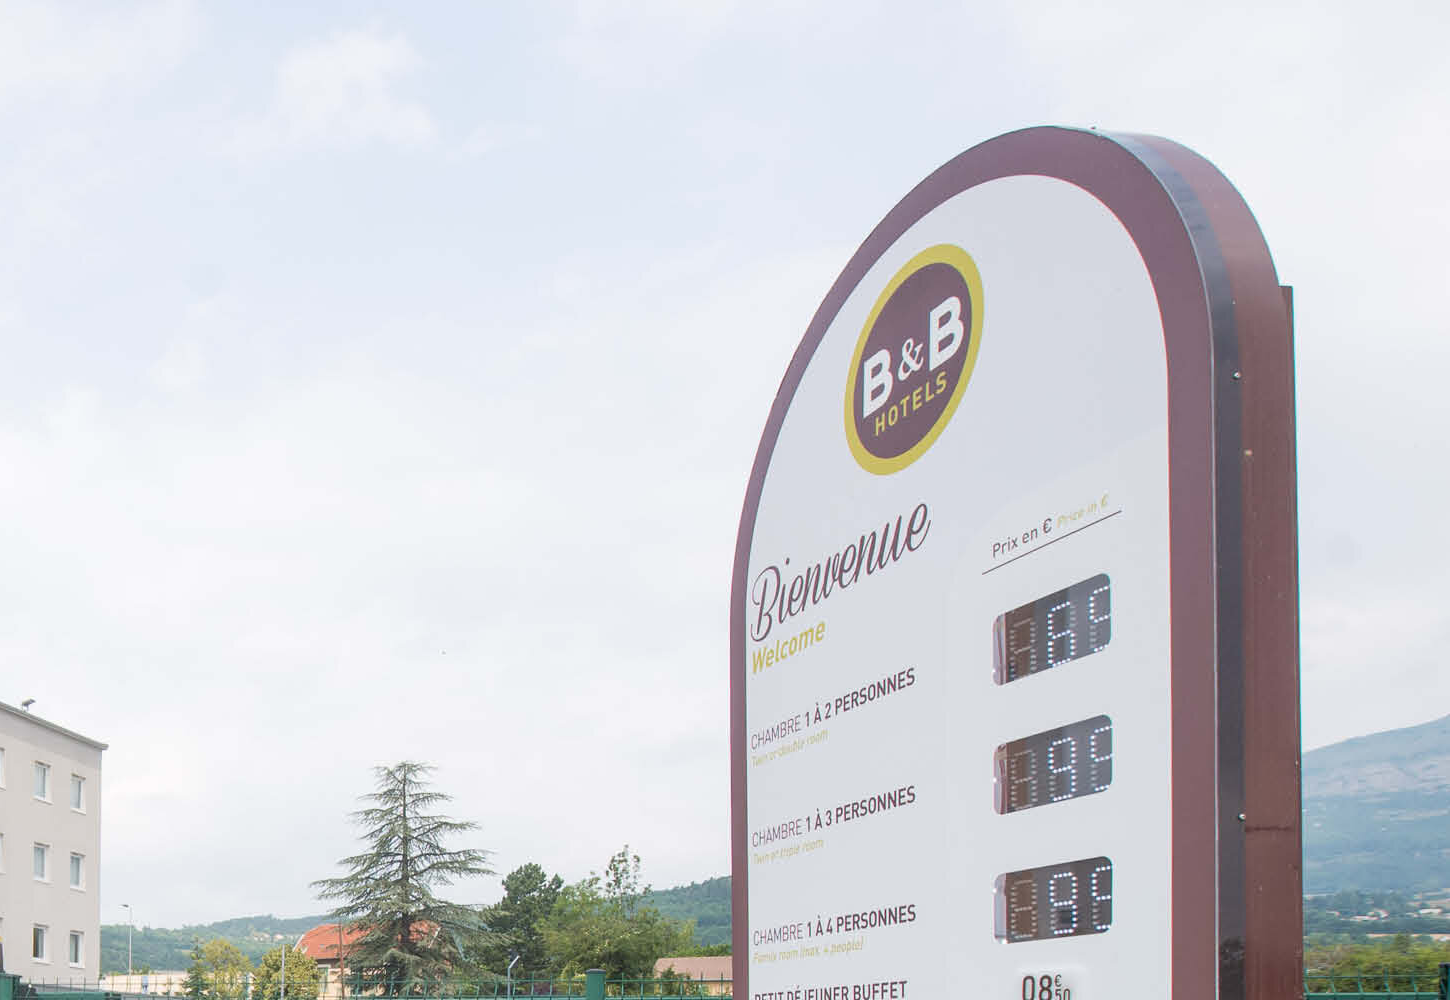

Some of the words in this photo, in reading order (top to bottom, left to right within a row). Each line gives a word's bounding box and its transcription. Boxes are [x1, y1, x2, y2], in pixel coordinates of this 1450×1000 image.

[862, 296, 965, 419] B&B
[875, 371, 947, 436] HOTELS
[992, 537, 1018, 558] Prix
[1022, 527, 1038, 544] en
[1042, 518, 1052, 534] €
[751, 503, 931, 641] Bienvenue
[752, 621, 825, 674] Welcome
[751, 715, 801, 750] CHAMBRE
[805, 711, 810, 727] 1
[813, 702, 822, 724] À
[825, 702, 832, 720] 2
[835, 667, 915, 715] PERSONNES
[752, 819, 802, 847] CHAMBRE
[805, 816, 811, 832] 1
[814, 809, 822, 830] À
[826, 810, 832, 827] 3
[835, 786, 916, 824] PERSONNES
[753, 923, 803, 946] CHAMBRE
[807, 921, 812, 937] 1
[816, 915, 823, 936] À
[826, 918, 833, 934] 4
[836, 904, 916, 933] PERSONNES
[853, 980, 908, 1000] BUFFET
